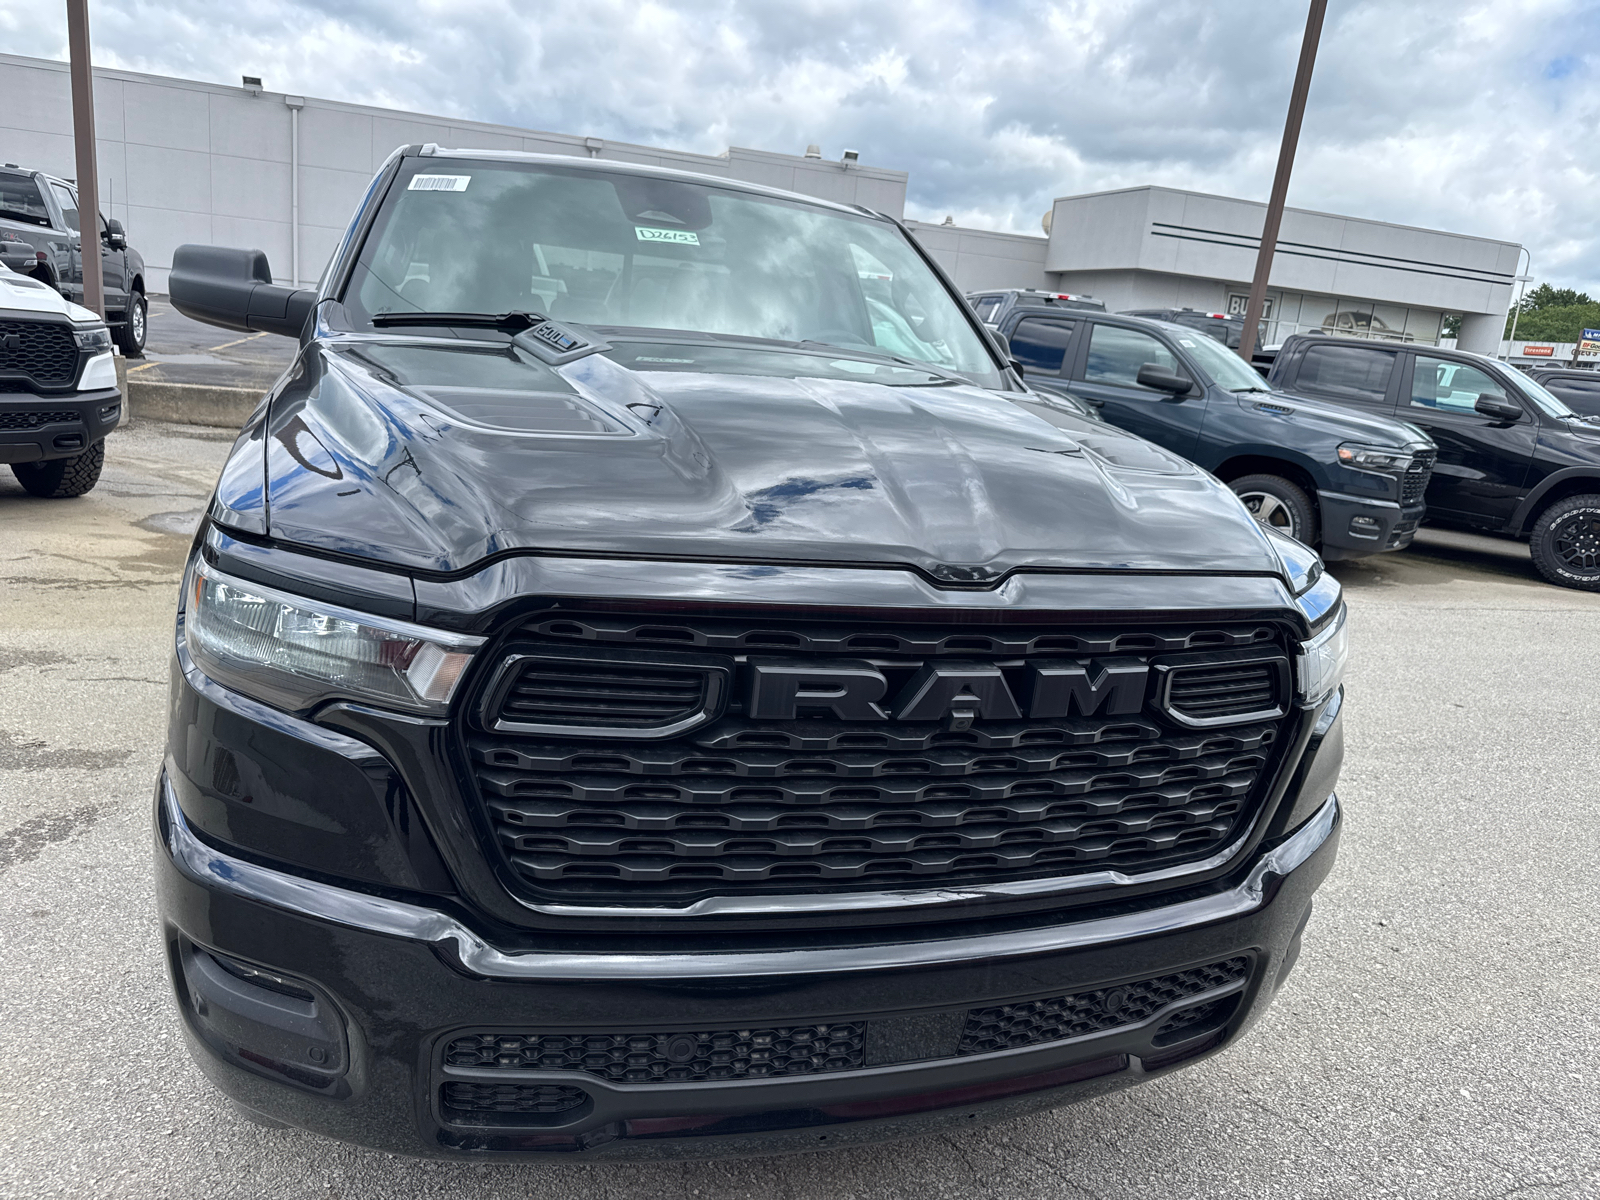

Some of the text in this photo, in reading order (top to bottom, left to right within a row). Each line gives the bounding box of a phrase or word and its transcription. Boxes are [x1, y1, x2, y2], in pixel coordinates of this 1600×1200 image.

[639, 229, 698, 243] D26153
[1229, 297, 1272, 318] BUT
[749, 660, 1150, 721] RAM
